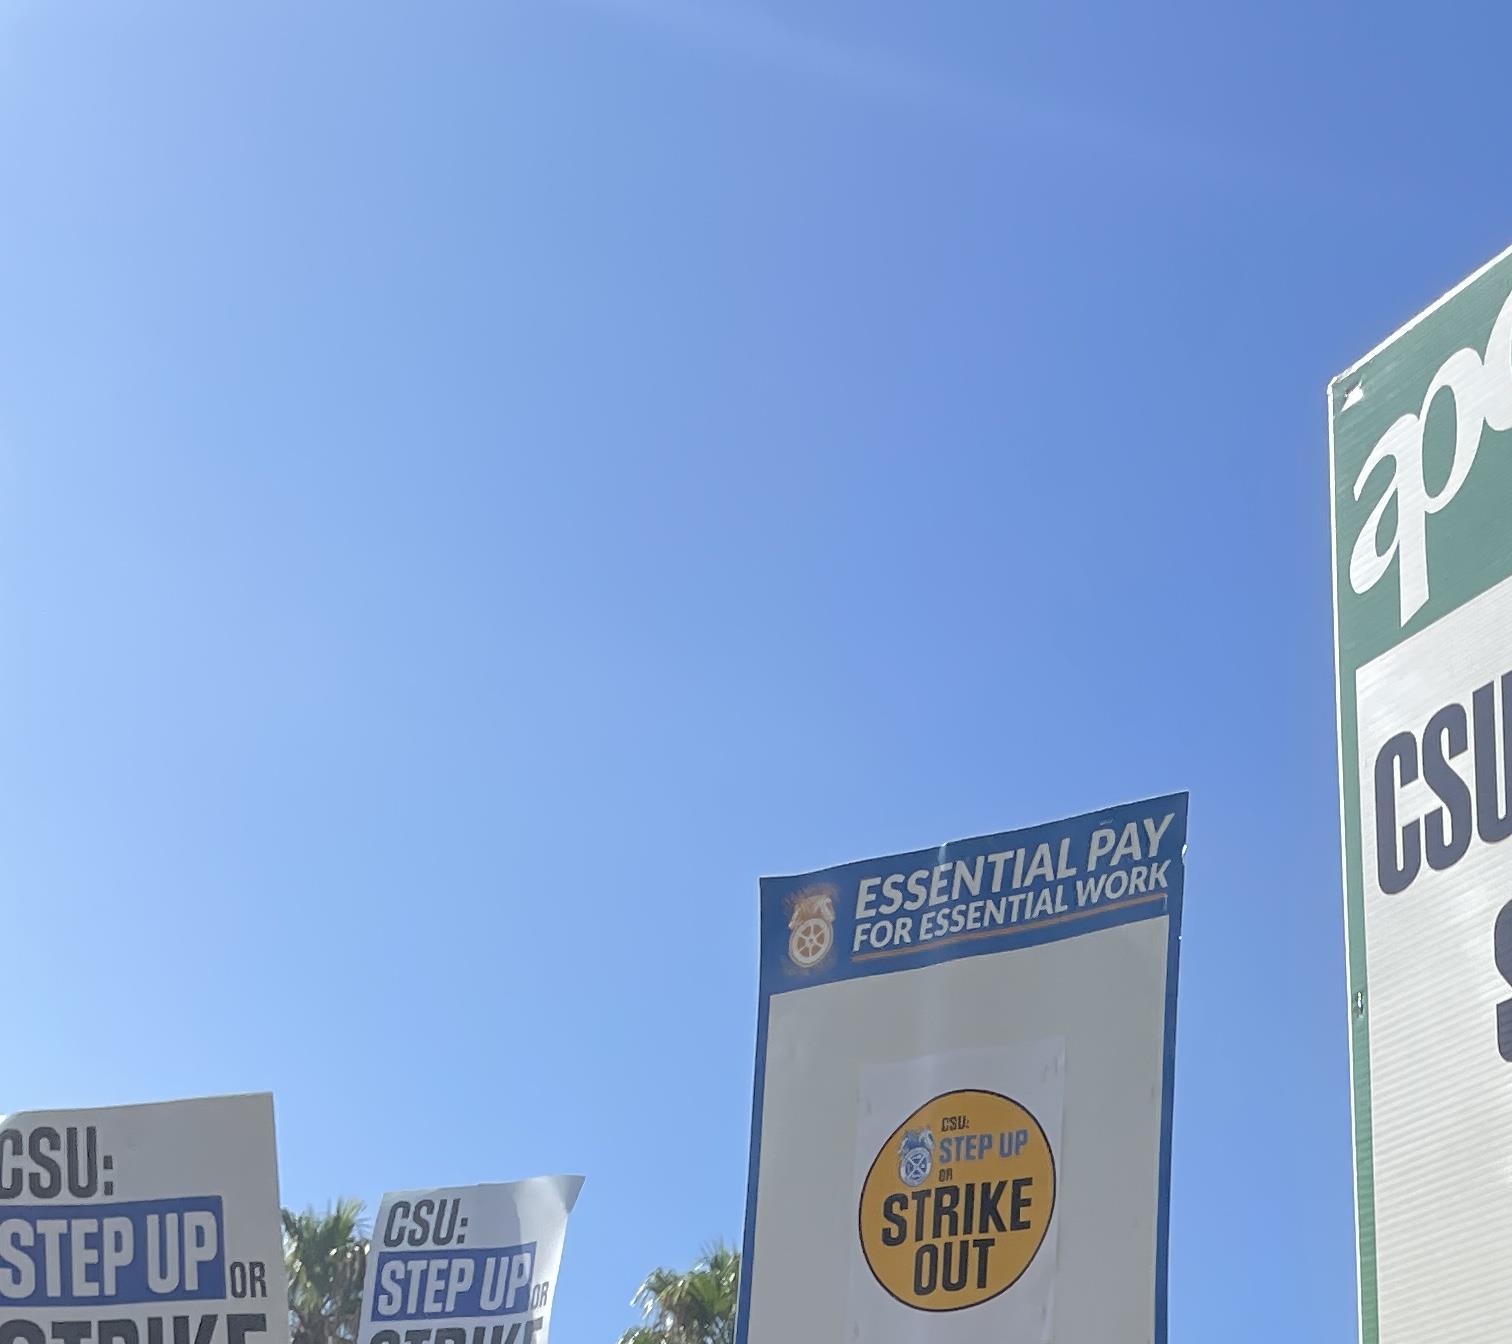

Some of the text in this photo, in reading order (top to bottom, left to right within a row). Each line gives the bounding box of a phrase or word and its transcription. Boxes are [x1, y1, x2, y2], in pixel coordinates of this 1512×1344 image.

[855, 813, 1175, 920] ESSENTIAL PAY
[853, 860, 1171, 953] FOR ESSENTIAL WORK
[0, 1125, 114, 1198] CSU:
[938, 1129, 1029, 1164] STEP UP
[383, 1198, 468, 1247] CSU:
[881, 1177, 1033, 1247] STRIKE
[0, 1211, 267, 1299] STEP UP OR
[377, 1253, 549, 1316] STEP UP OR
[914, 1238, 995, 1295] OUT
